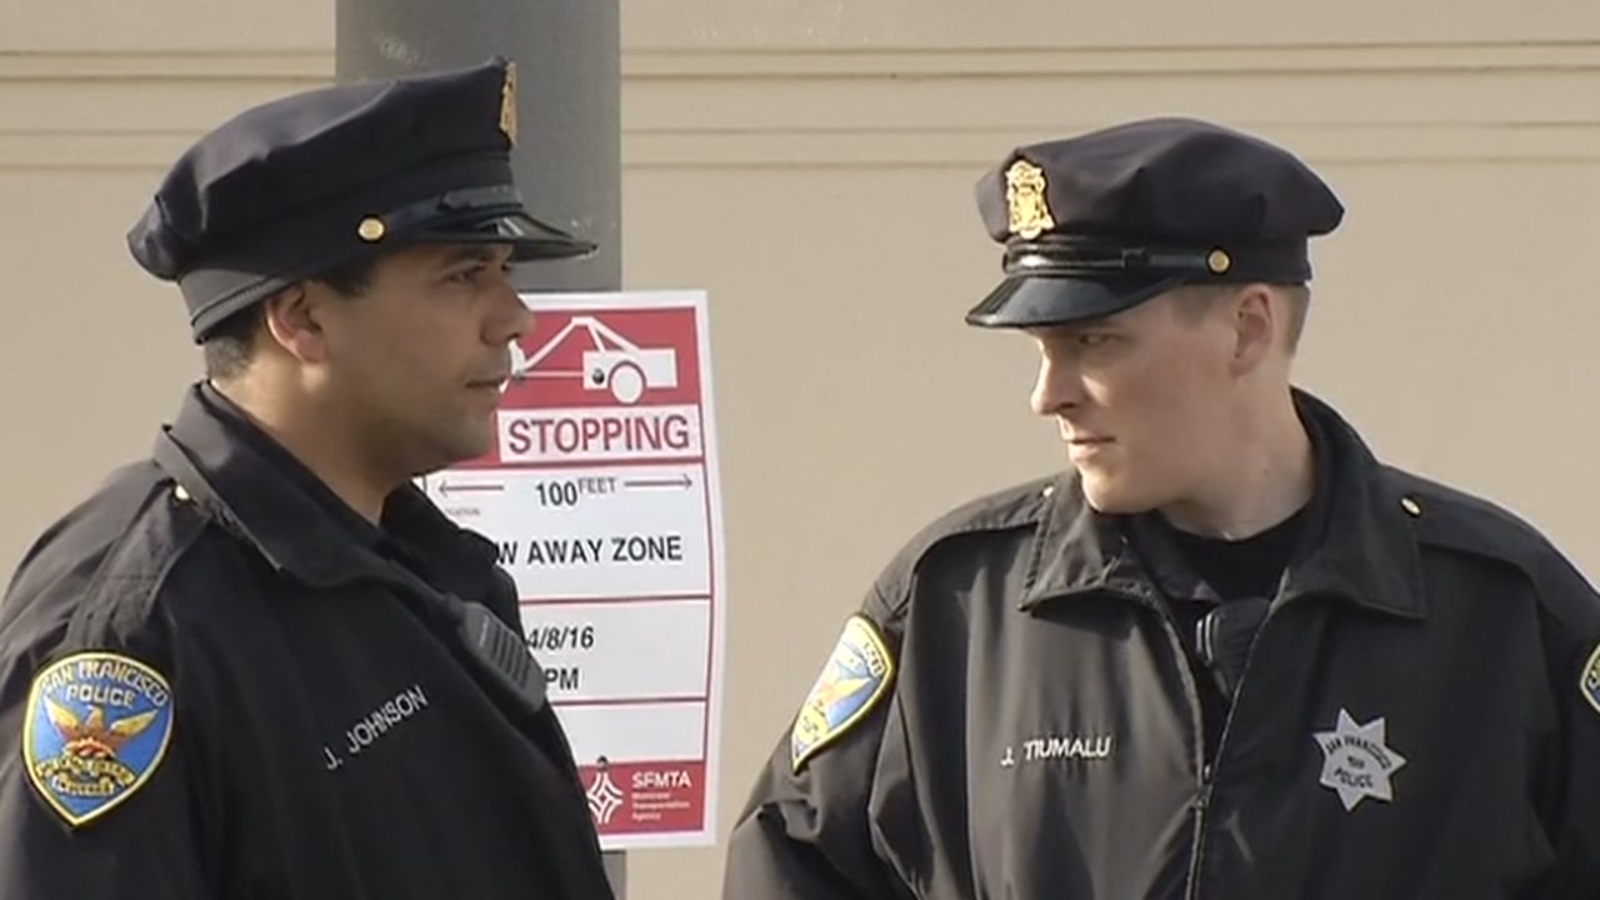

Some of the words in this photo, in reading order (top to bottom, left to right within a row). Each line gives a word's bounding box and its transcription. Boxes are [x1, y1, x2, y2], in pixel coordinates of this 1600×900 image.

[508, 415, 690, 455] STOPPING
[535, 482, 578, 507] 100
[578, 476, 617, 495] FEET
[497, 541, 518, 565] W
[527, 538, 603, 564] AWAY
[612, 536, 683, 562] ZONE
[41, 662, 74, 693] SAN
[78, 660, 169, 708] FRANCISCO
[65, 684, 136, 708] POLICE
[323, 747, 343, 770] J.
[345, 684, 429, 753] JOHNSON
[632, 770, 693, 789] SFMTA
[1334, 766, 1375, 788] POLICE
